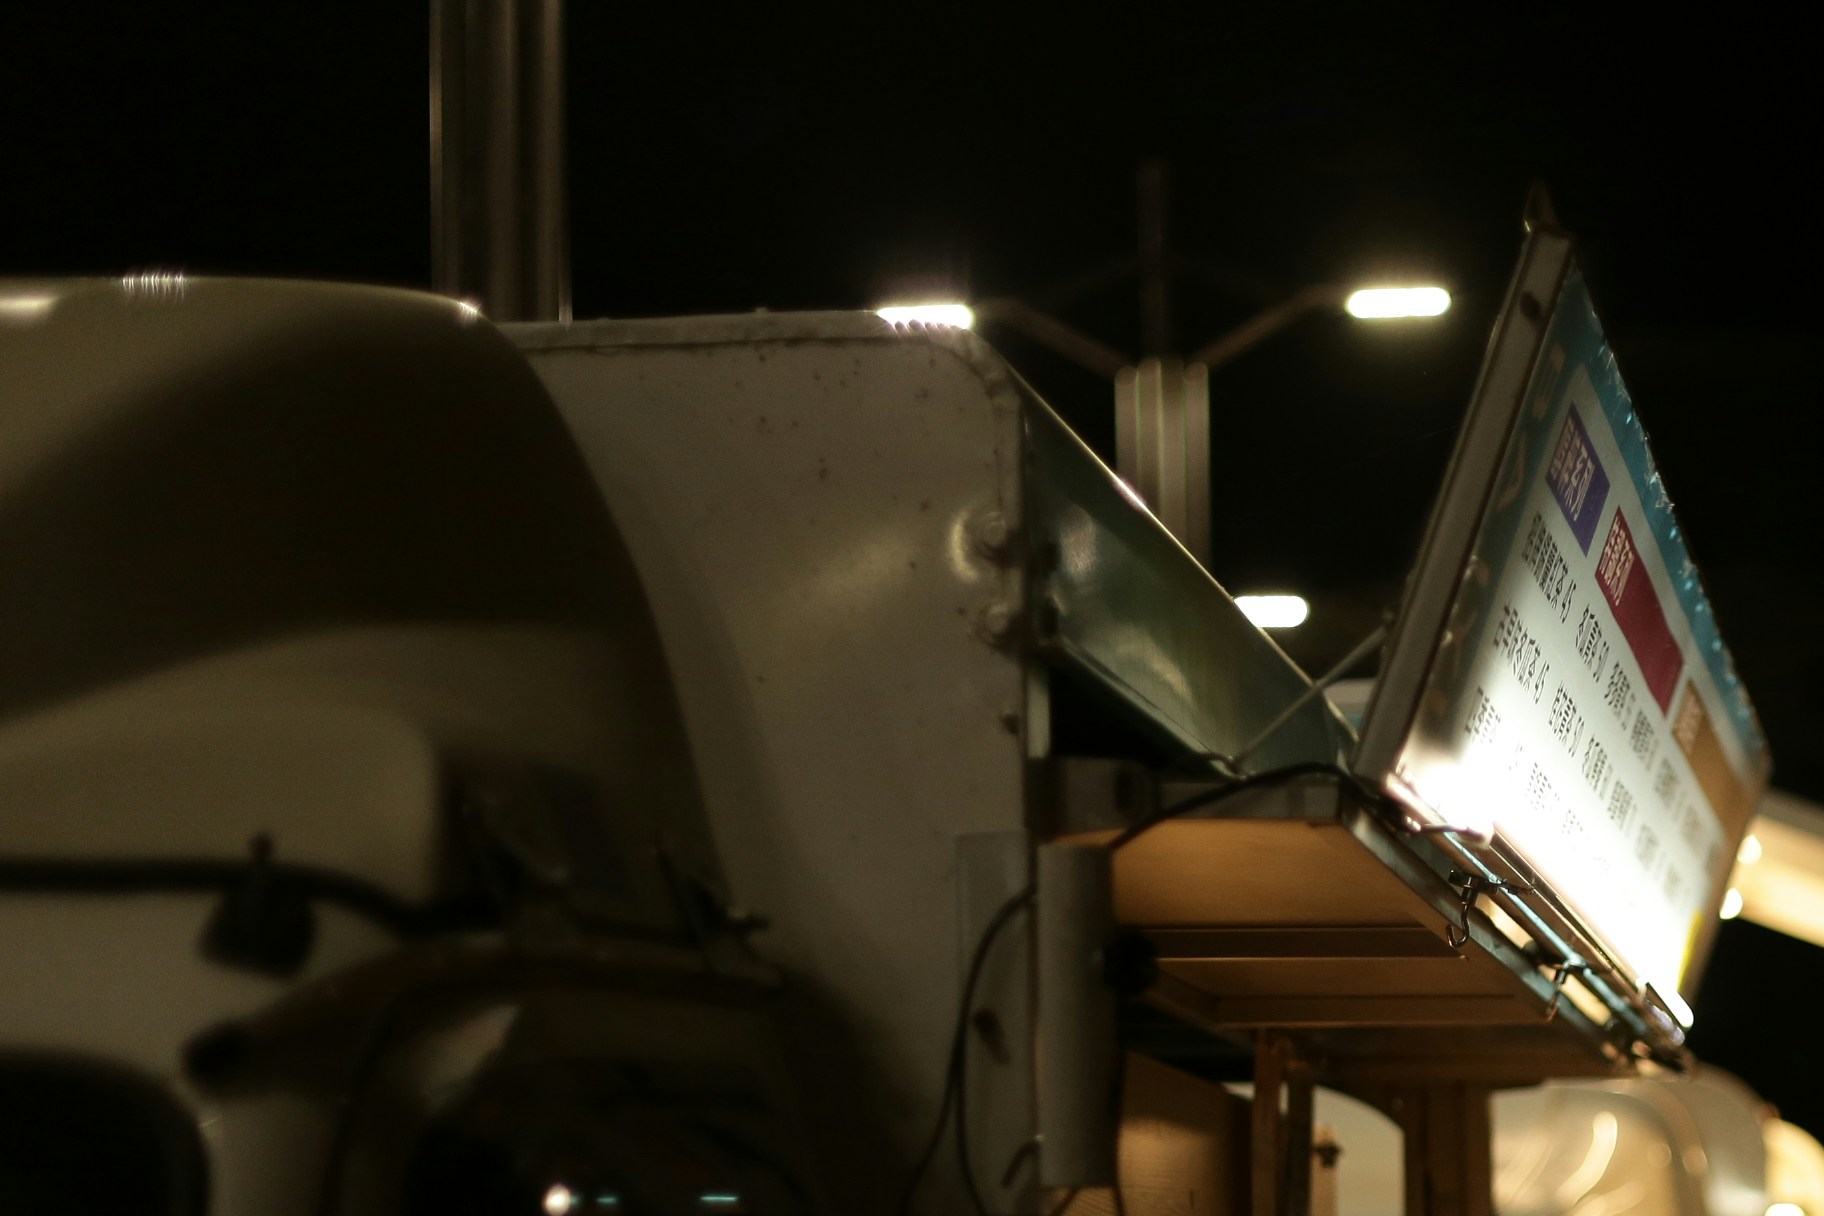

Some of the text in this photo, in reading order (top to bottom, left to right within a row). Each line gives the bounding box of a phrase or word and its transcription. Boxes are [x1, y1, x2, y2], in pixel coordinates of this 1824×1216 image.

[1596, 513, 1636, 610] 特調系列
[1556, 574, 1578, 627] 45
[1571, 598, 1605, 673] 冬瓜青茶
[1490, 597, 1551, 707] 古早味冬瓜茶 45
[1545, 677, 1580, 749] 桂花青茶
